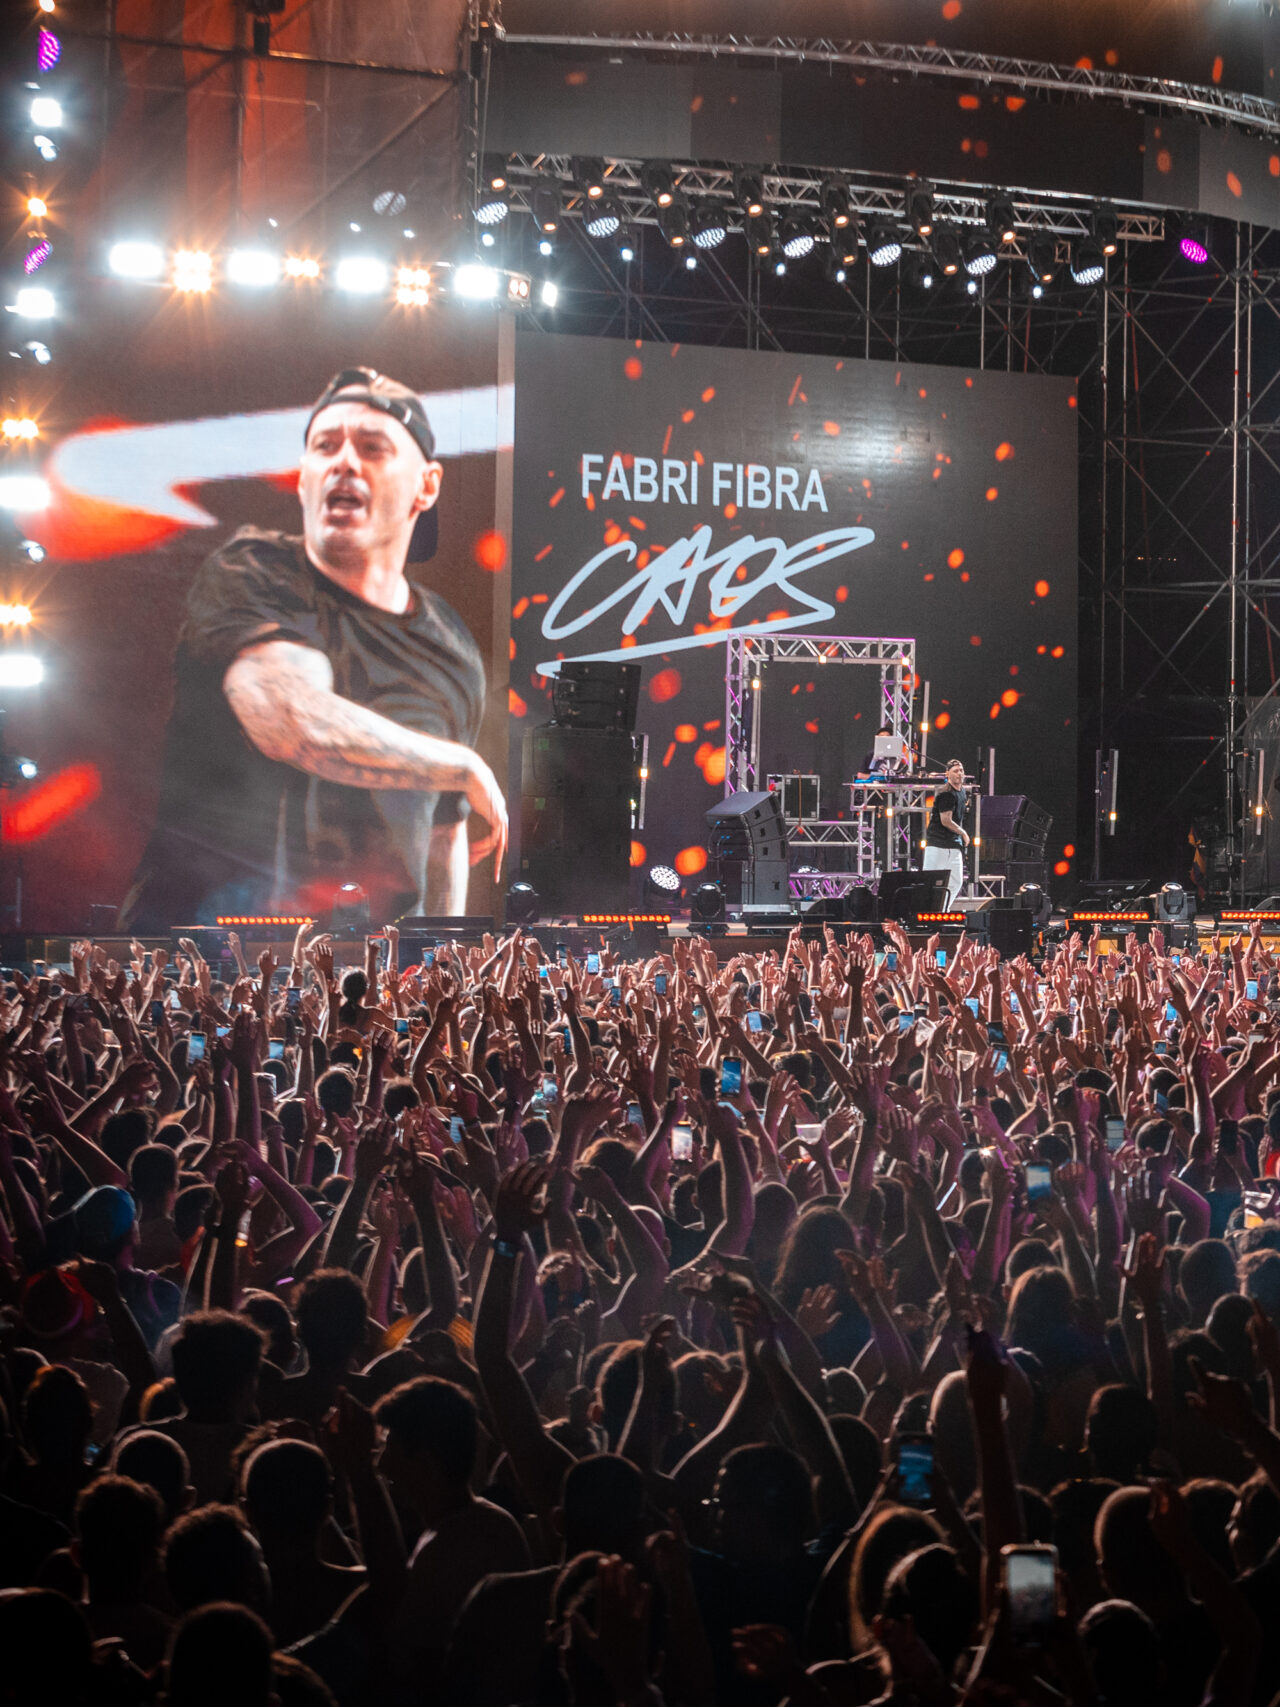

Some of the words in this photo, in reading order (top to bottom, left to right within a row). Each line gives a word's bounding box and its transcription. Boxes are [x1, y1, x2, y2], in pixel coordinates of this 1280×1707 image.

[581, 453, 698, 505] FABRI
[712, 462, 829, 512] FIBRA
[537, 525, 875, 677] CAOS
